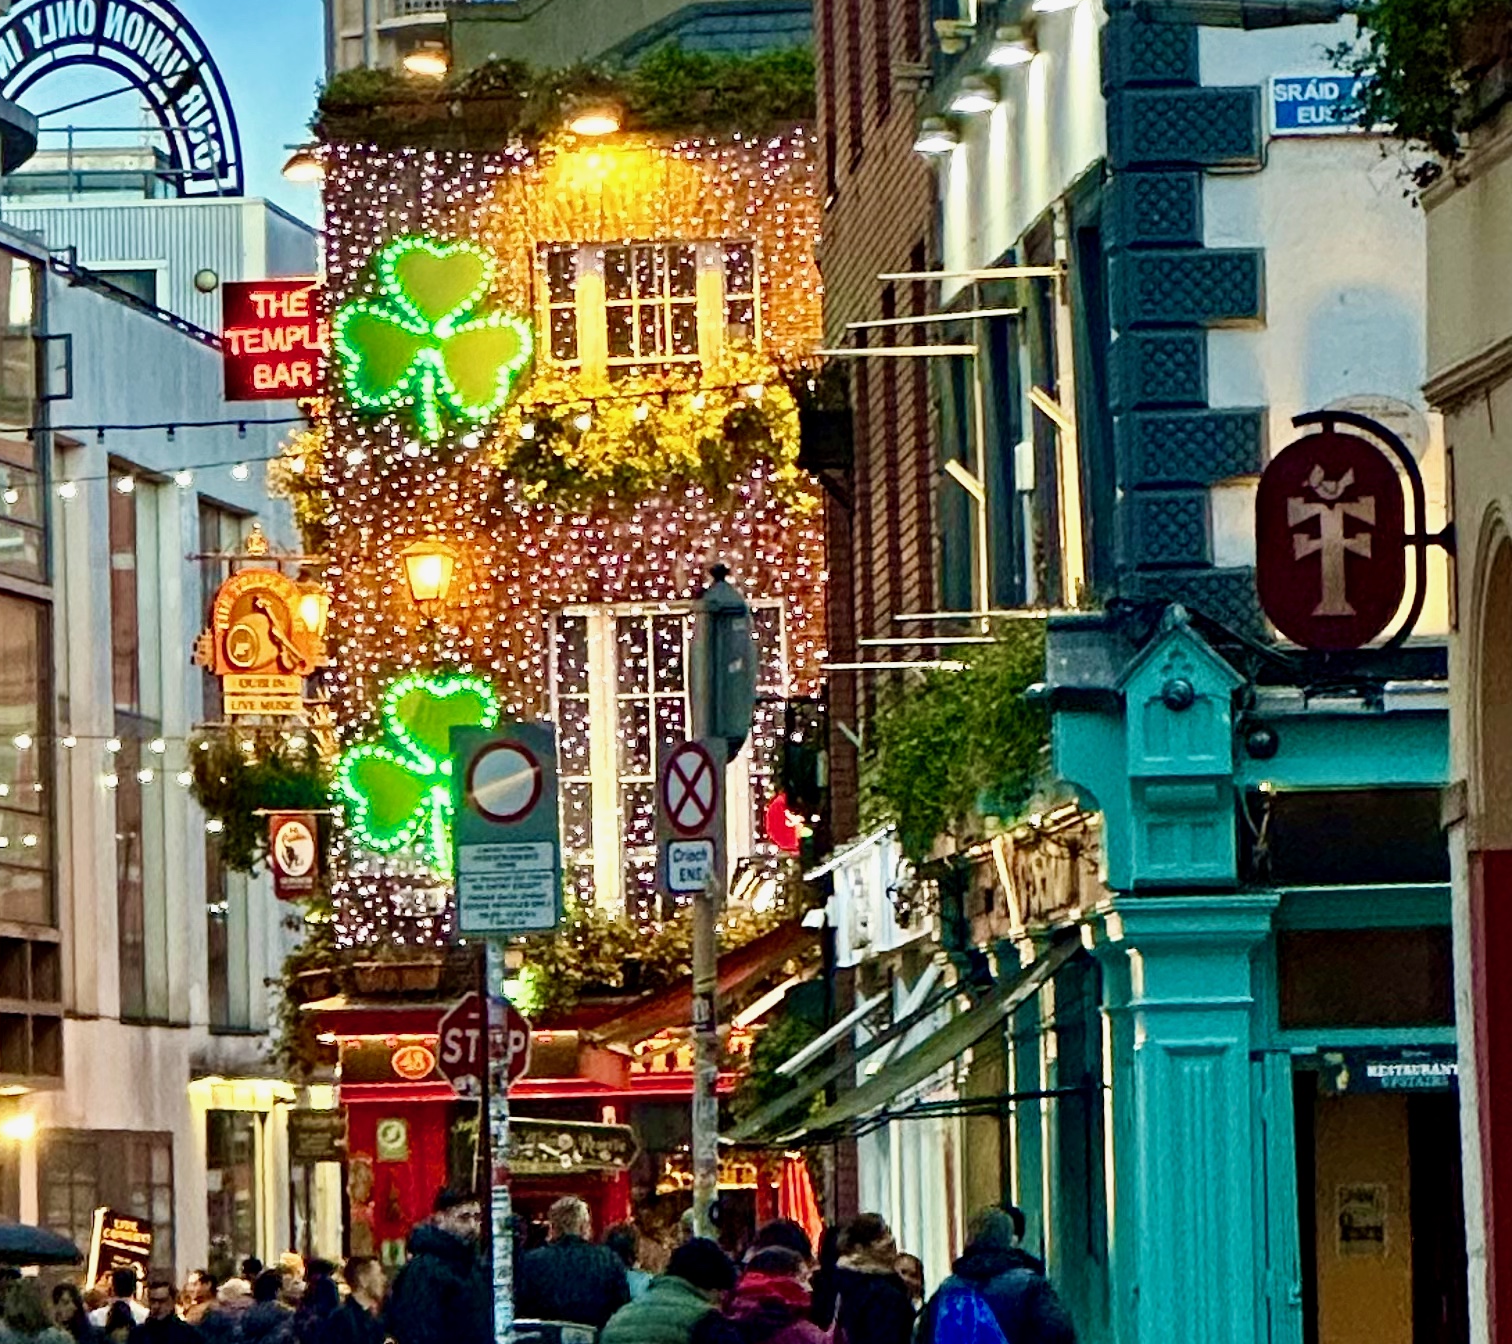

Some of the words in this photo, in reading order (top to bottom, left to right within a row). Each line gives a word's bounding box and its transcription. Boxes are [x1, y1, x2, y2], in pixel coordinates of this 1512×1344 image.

[1274, 78, 1340, 102] SRÁID
[249, 290, 309, 319] THE
[224, 325, 330, 356] TEMPLE
[253, 361, 313, 390] BAR
[442, 1026, 526, 1064] STP
